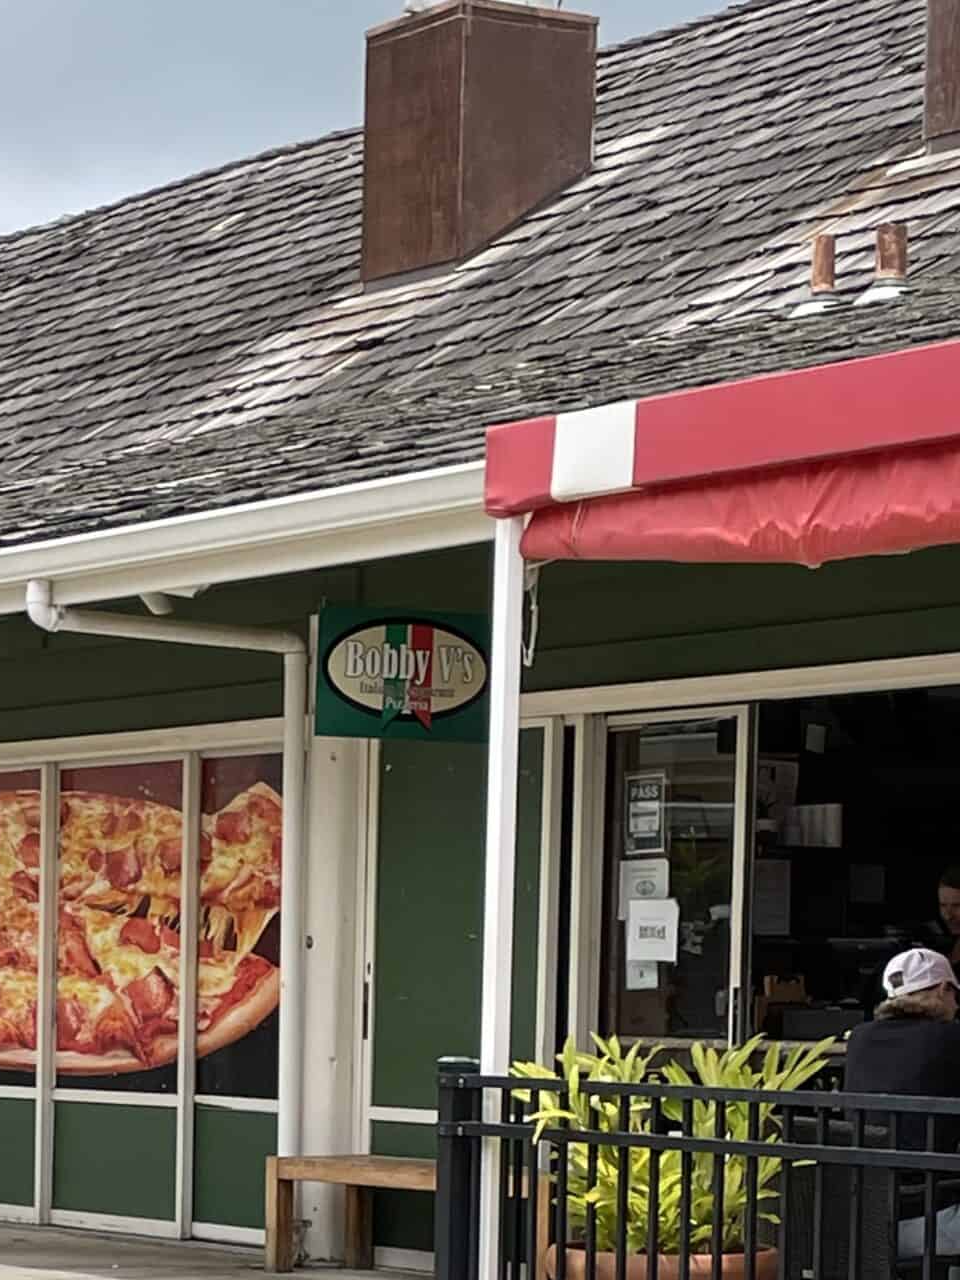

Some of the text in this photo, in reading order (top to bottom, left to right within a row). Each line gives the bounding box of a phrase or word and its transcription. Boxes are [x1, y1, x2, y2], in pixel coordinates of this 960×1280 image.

[345, 640, 474, 686] Bobby V's
[631, 785, 659, 799] PASS
